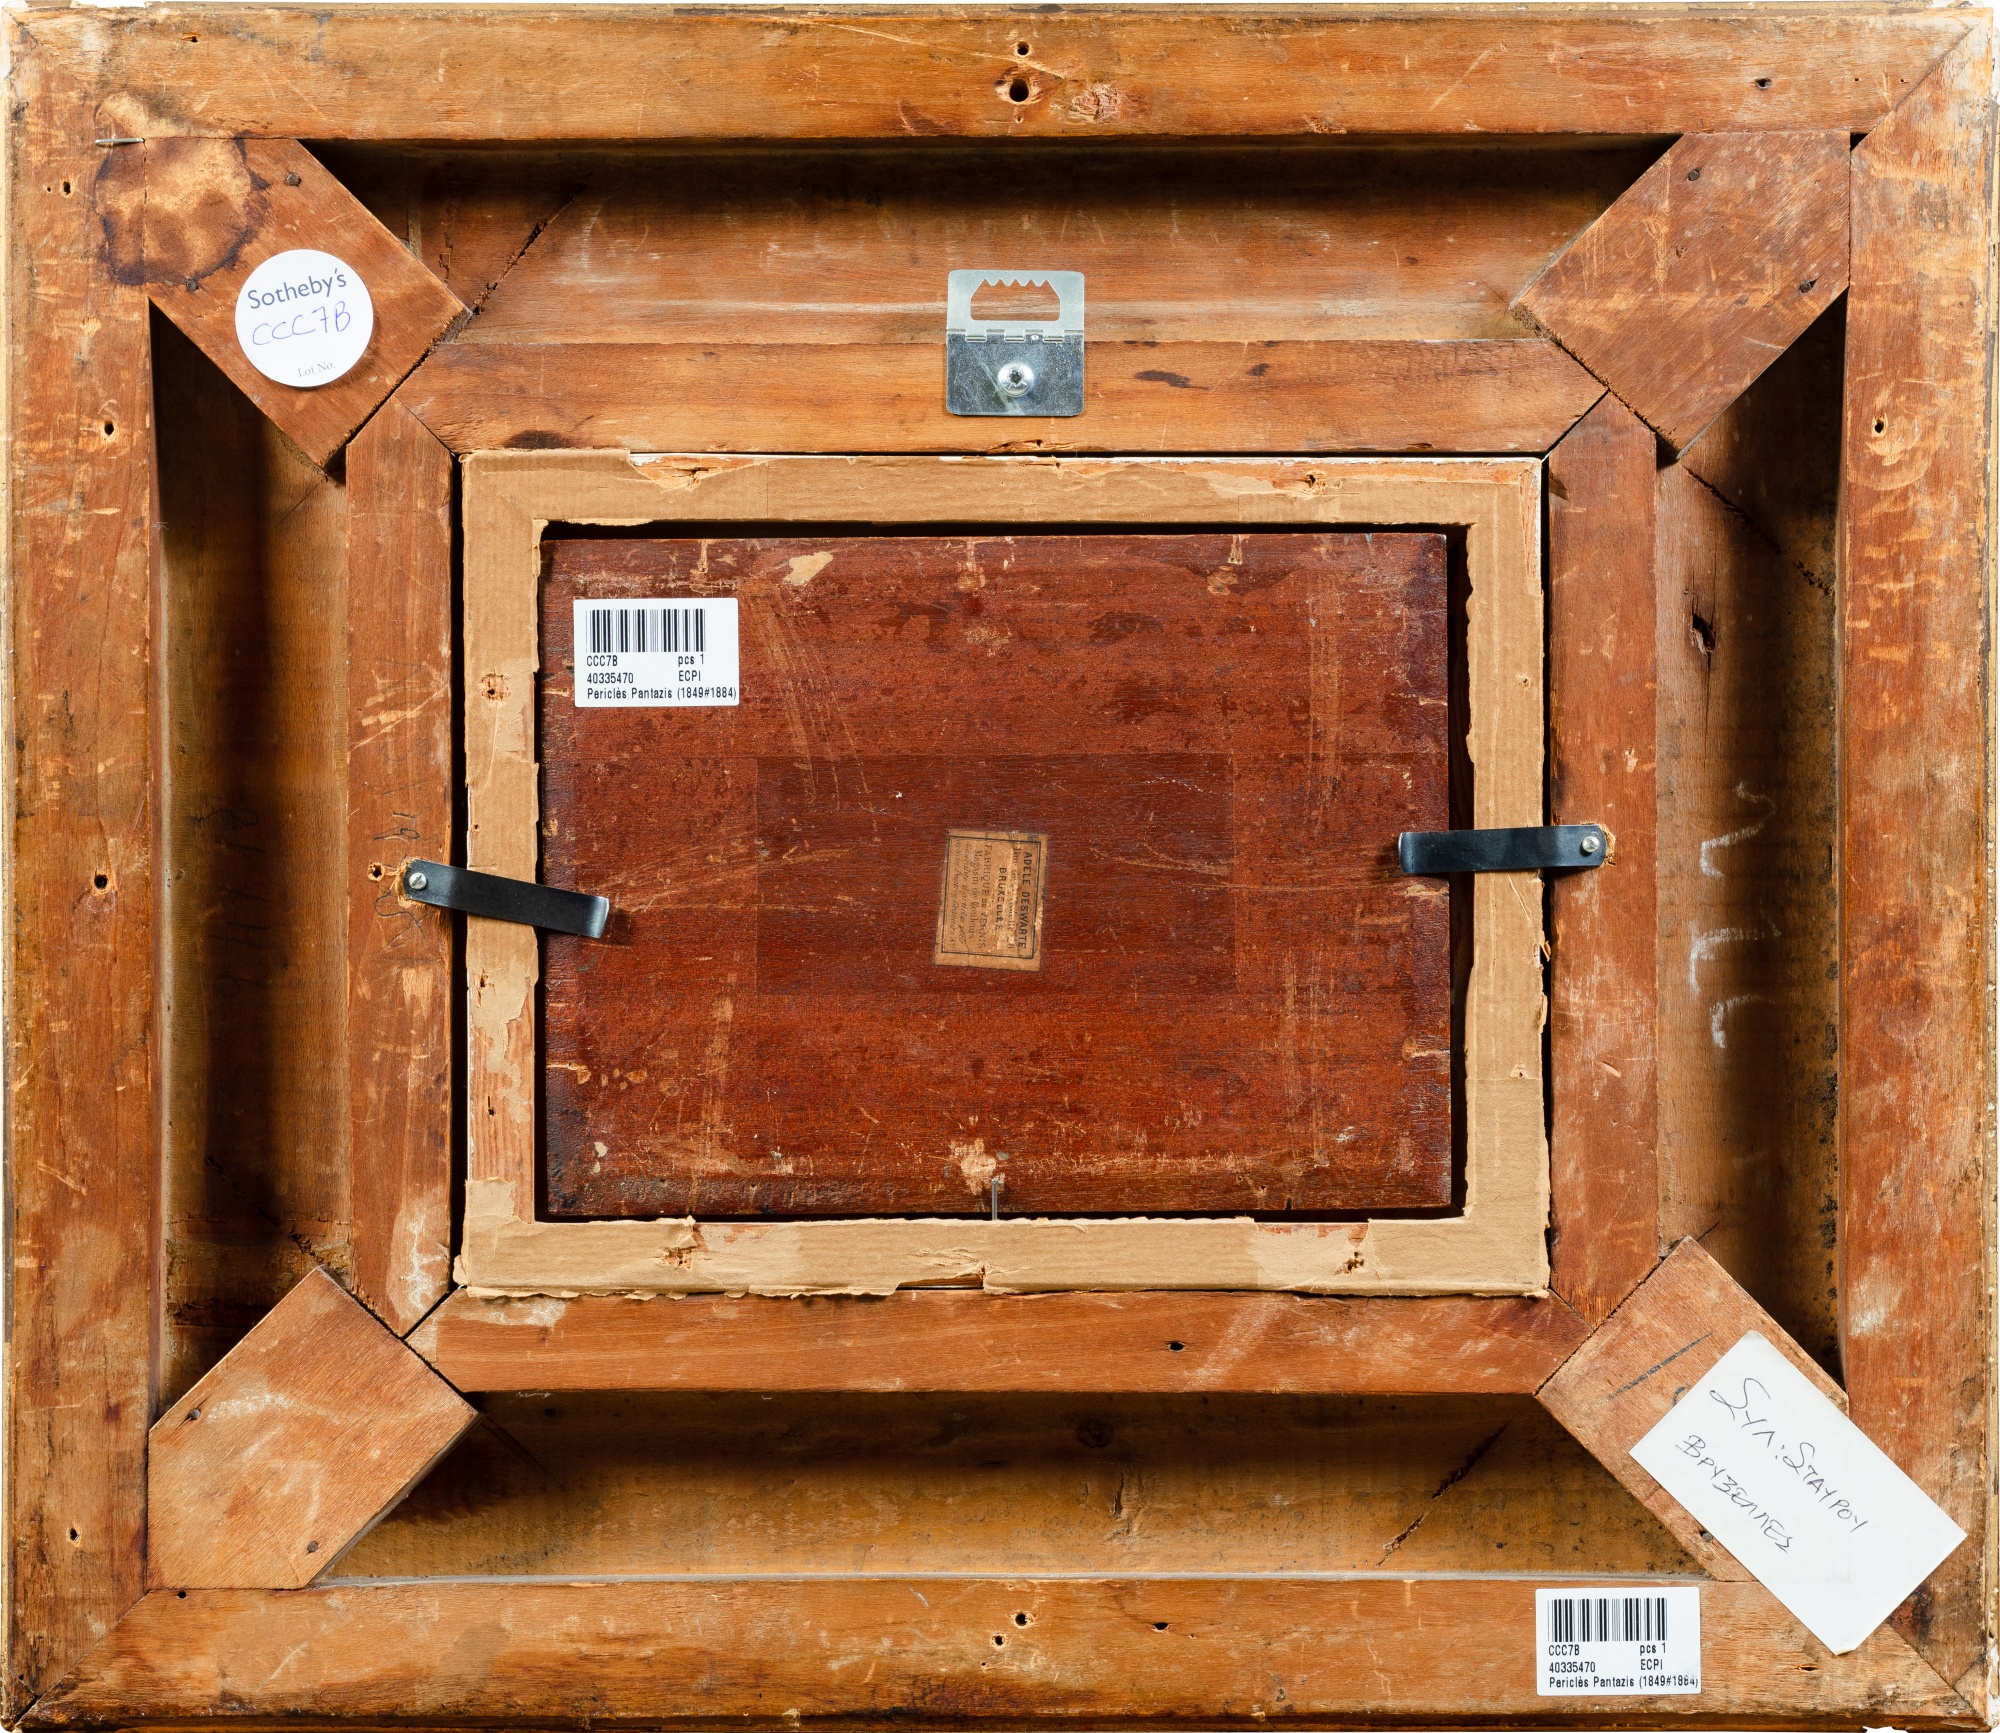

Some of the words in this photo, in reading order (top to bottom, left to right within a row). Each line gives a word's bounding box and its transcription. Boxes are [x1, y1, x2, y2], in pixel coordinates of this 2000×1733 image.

[248, 268, 347, 309] Sotheby's
[252, 301, 351, 346] CCC7B
[297, 367, 315, 378] Lot
[317, 361, 336, 373] No.
[586, 655, 618, 667] CCC7B
[678, 656, 695, 667] pcs
[699, 654, 704, 665] 1
[587, 672, 634, 684] 40335470
[679, 670, 701, 682] ECPI
[587, 687, 627, 699] Periclès
[631, 687, 673, 699] Pantazis
[677, 686, 737, 701] (1849#1884)
[969, 849, 982, 884] Magasin
[979, 844, 992, 895] FABRIQUE
[971, 888, 979, 897] de
[968, 901, 978, 939] Couleurs
[1017, 891, 1030, 948] DESWARTE
[956, 924, 965, 944] pour
[978, 911, 987, 948] VERNIS
[1548, 1644, 1580, 1656] CCC7B
[1640, 1644, 1656, 1656] pcs
[1661, 1642, 1666, 1653] 1
[1549, 1662, 1595, 1673] 40335470
[1640, 1659, 1663, 1670] ECPI
[1549, 1676, 1588, 1688] Periclès
[1593, 1676, 1634, 1688] Pantazis
